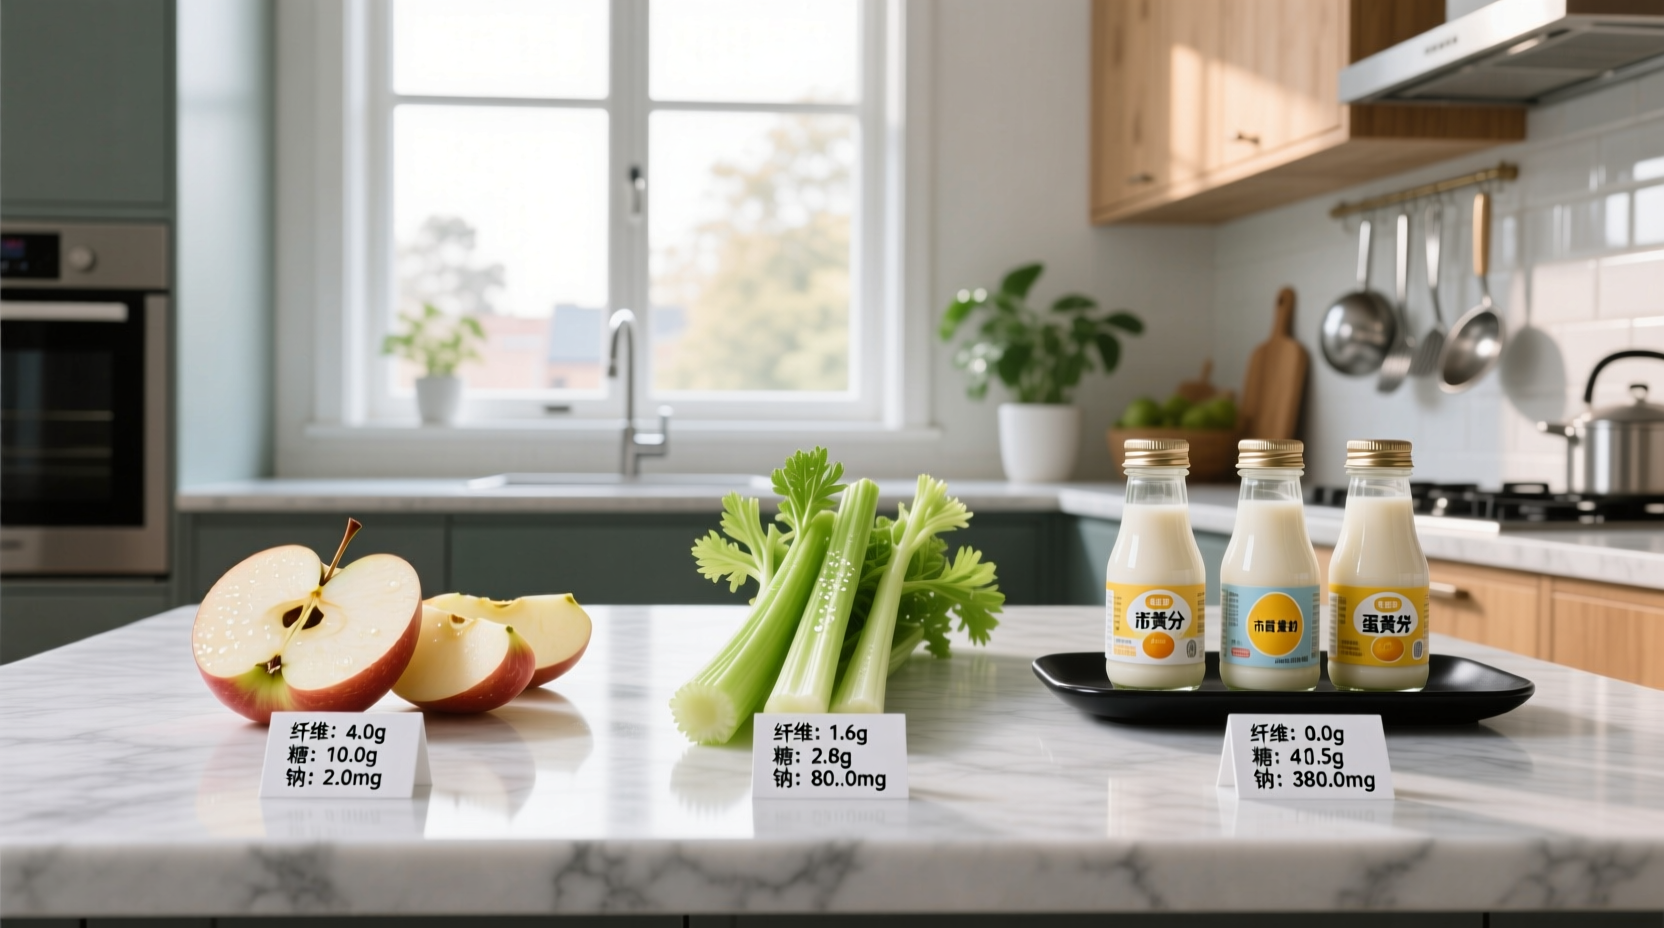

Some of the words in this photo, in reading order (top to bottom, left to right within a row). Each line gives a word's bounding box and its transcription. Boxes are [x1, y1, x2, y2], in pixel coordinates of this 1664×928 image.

[289, 721, 337, 743] 纤维：
[346, 723, 387, 745] 4.0g
[773, 721, 820, 743] 纤维：
[829, 724, 868, 746] 1.6g
[1250, 723, 1296, 744] 纤维：
[1304, 724, 1345, 746] 0.0g
[286, 744, 316, 765] 糖：
[327, 746, 378, 768] 10.0g
[772, 745, 801, 767] 糖：
[811, 747, 852, 770] 2.8g
[1251, 746, 1280, 768] 糖：
[285, 766, 314, 789] 钠：
[322, 769, 383, 791] 2.0mg
[772, 767, 801, 789] 钠：
[1253, 768, 1283, 790] 钠：
[1292, 770, 1376, 793] 380.0mg
